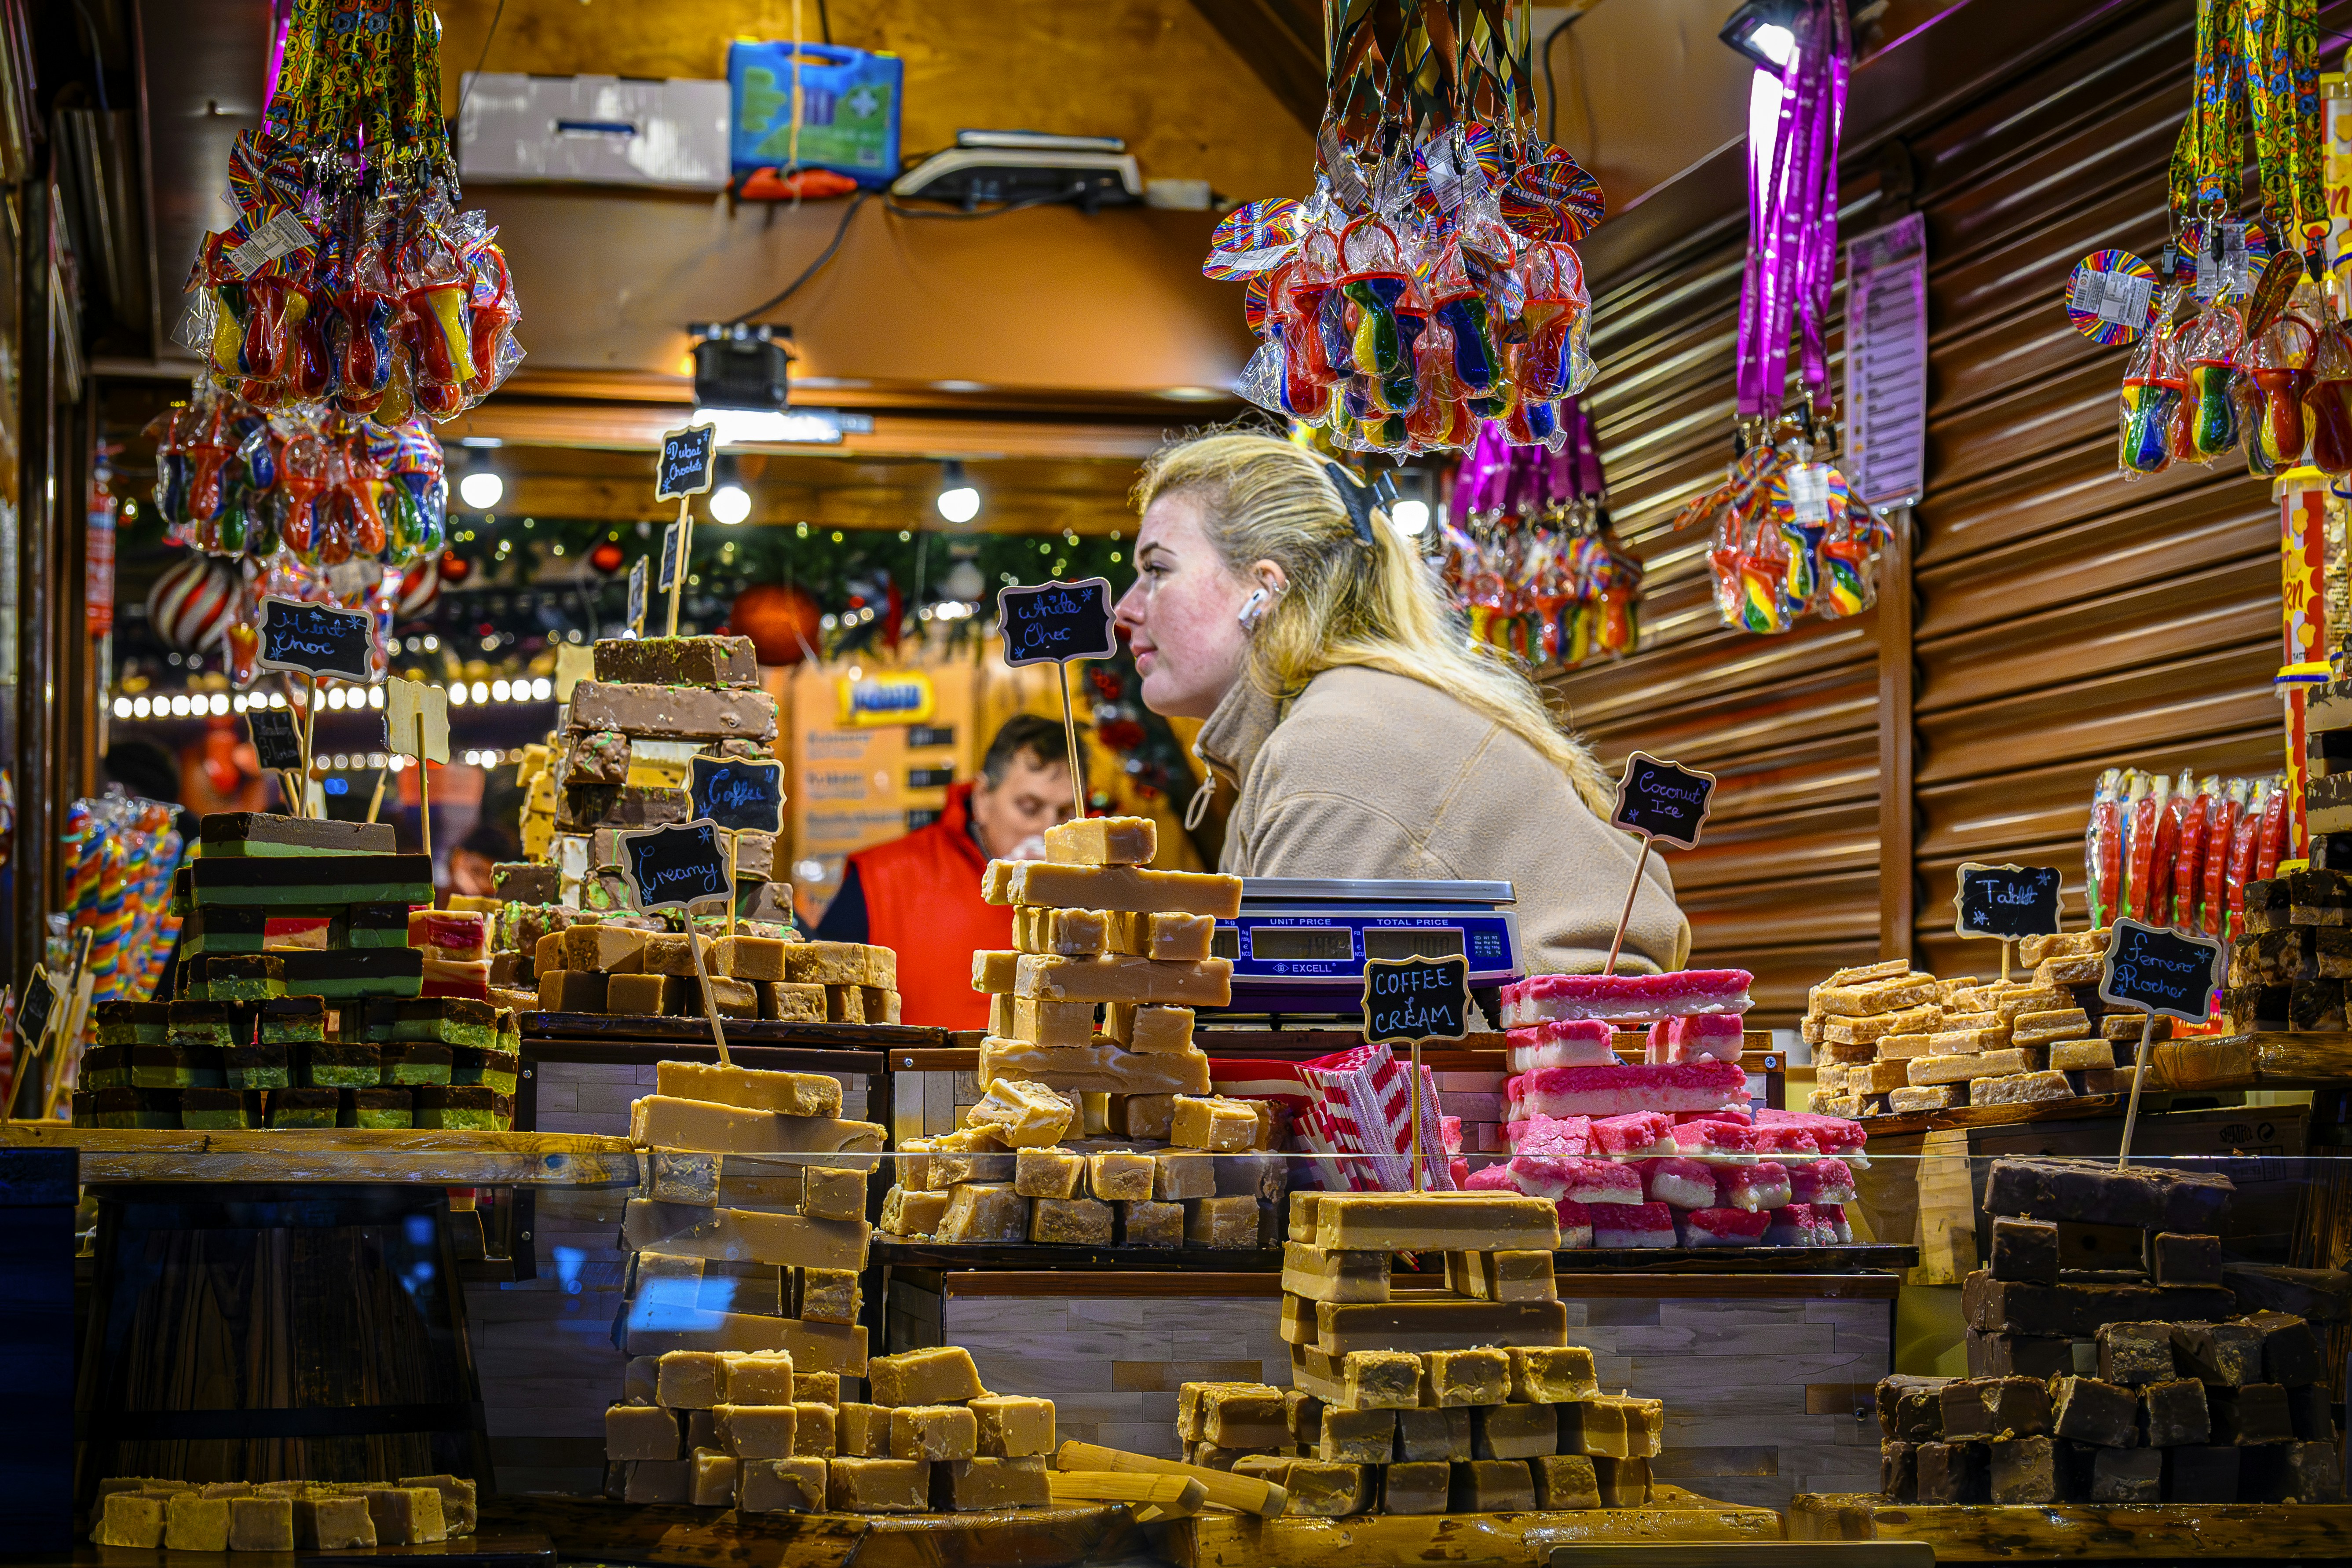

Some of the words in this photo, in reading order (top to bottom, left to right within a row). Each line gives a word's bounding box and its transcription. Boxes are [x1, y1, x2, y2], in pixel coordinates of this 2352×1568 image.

[1526, 174, 1568, 192] Lanyard
[1571, 188, 1597, 201] with
[1512, 188, 1562, 206] dummy
[1567, 203, 1596, 219] rock
[666, 439, 702, 461] Dubai
[273, 613, 347, 638] Mint
[1024, 622, 1071, 647] Choc
[274, 631, 335, 655] Choc
[1640, 771, 1702, 804] Coconut
[1651, 799, 1684, 818] Ice
[639, 846, 718, 892] Creamy
[1376, 968, 1452, 995] COFFEE
[2114, 964, 2187, 999] Rocher
[1375, 1005, 1455, 1034] CREAM
